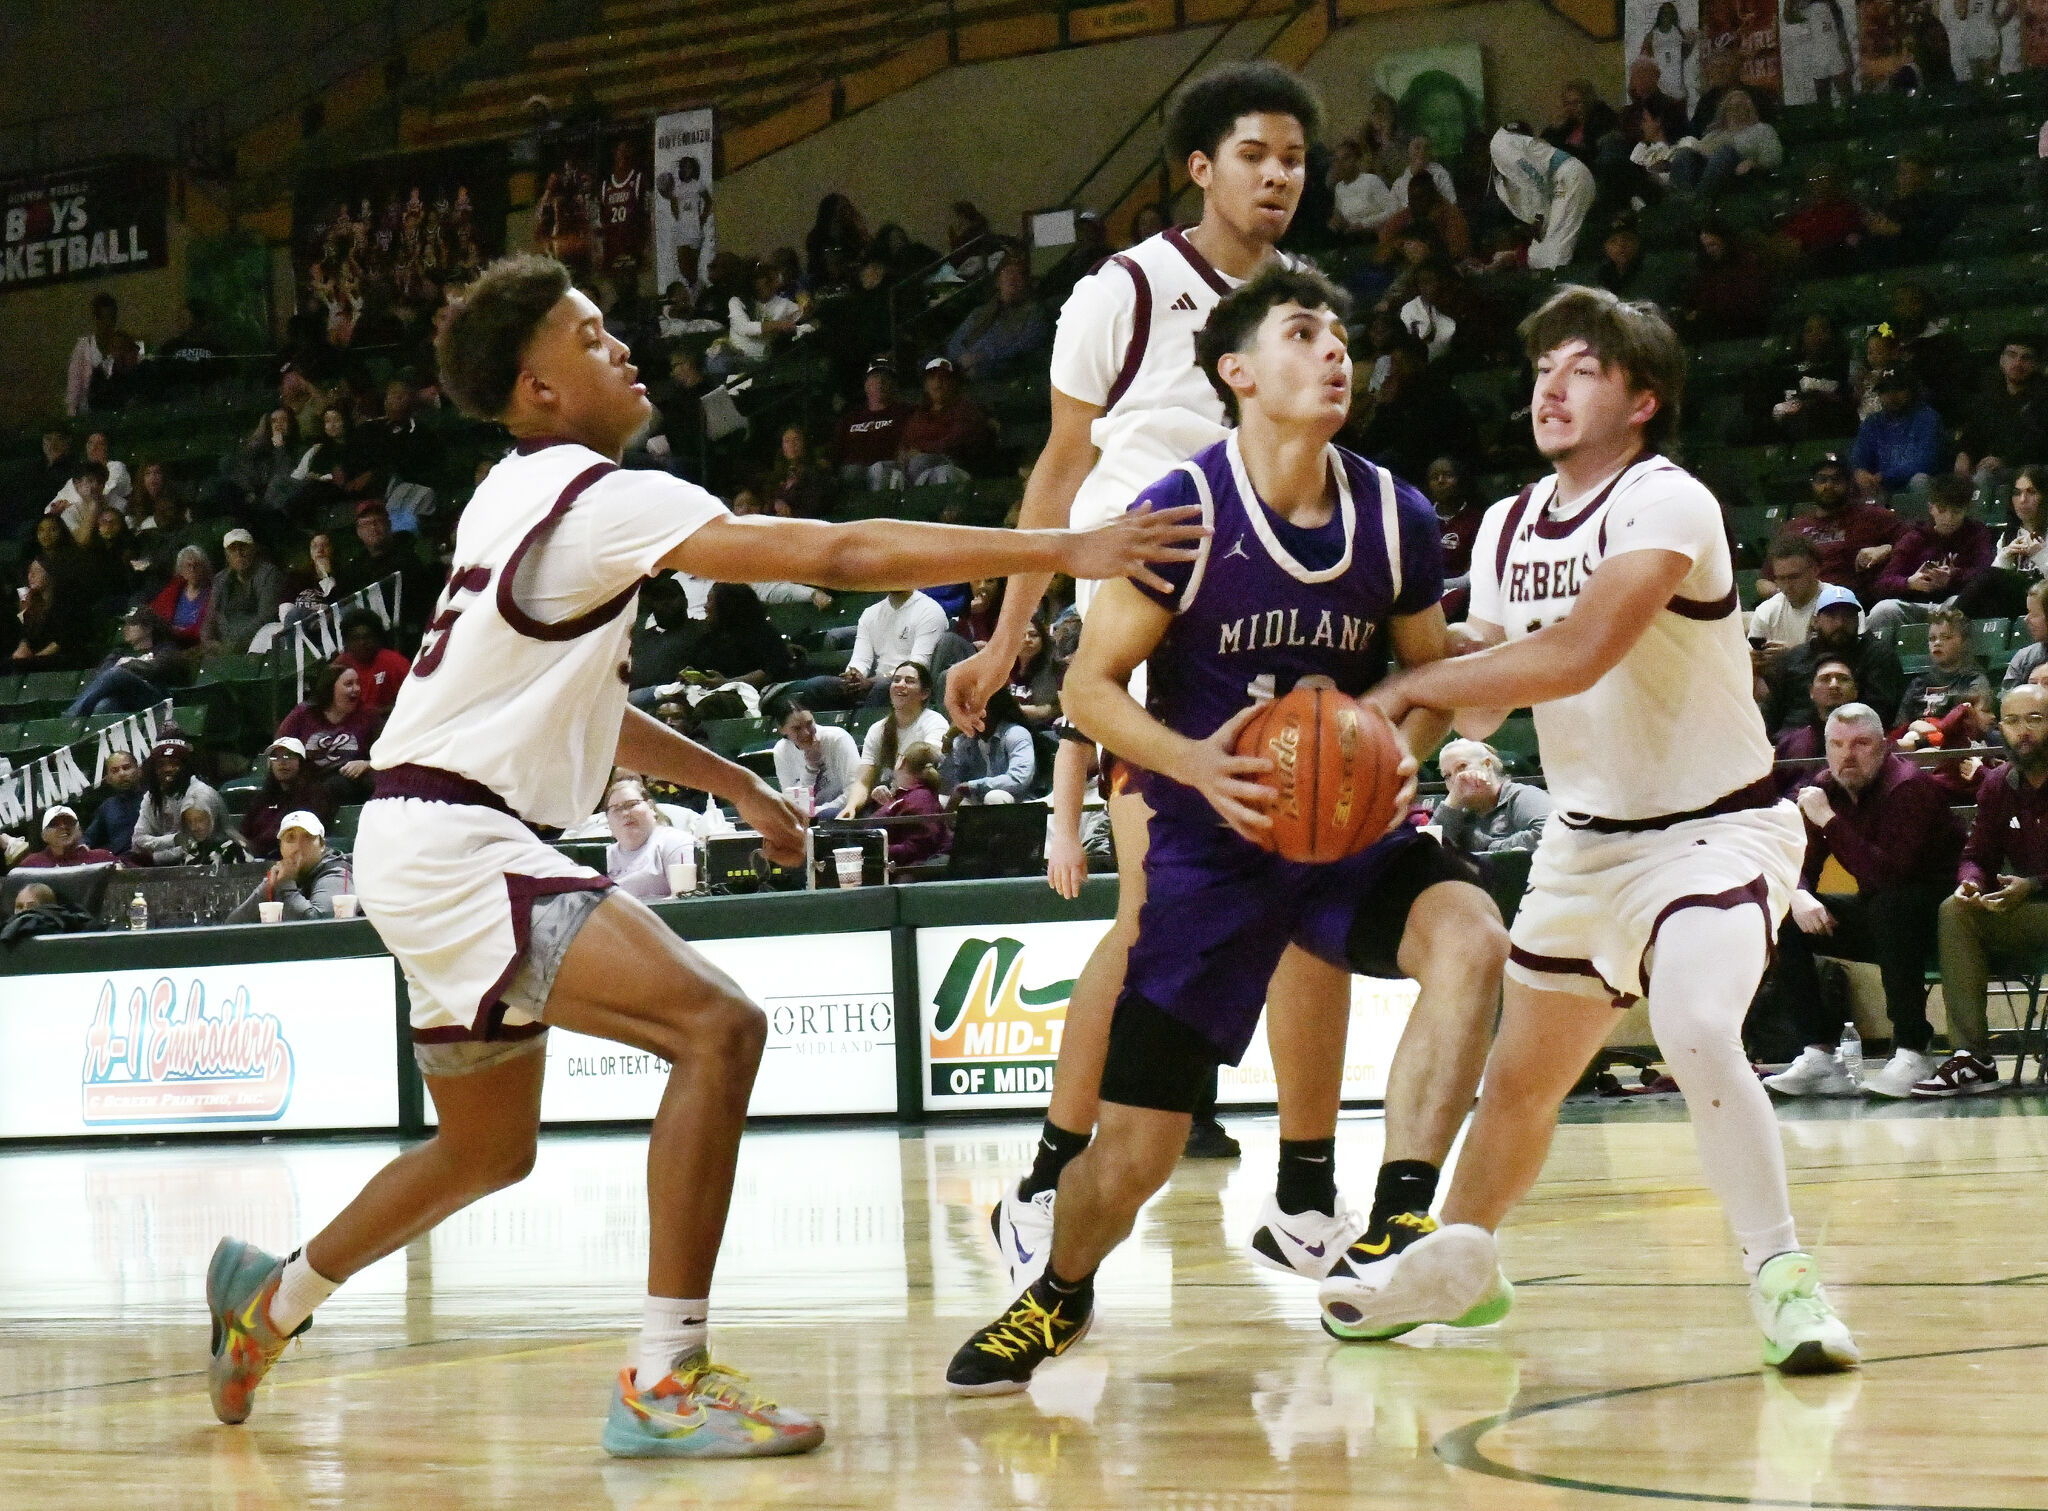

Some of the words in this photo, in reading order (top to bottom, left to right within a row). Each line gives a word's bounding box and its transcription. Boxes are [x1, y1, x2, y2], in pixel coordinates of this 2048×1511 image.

[0, 224, 149, 282] KETBALL
[774, 1002, 891, 1035] ORTHO
[796, 1040, 873, 1055] MIDLAND
[568, 1057, 597, 1076] CALL
[600, 1056, 616, 1075] OR
[619, 1055, 650, 1074] TEXT
[950, 1068, 986, 1093] OF
